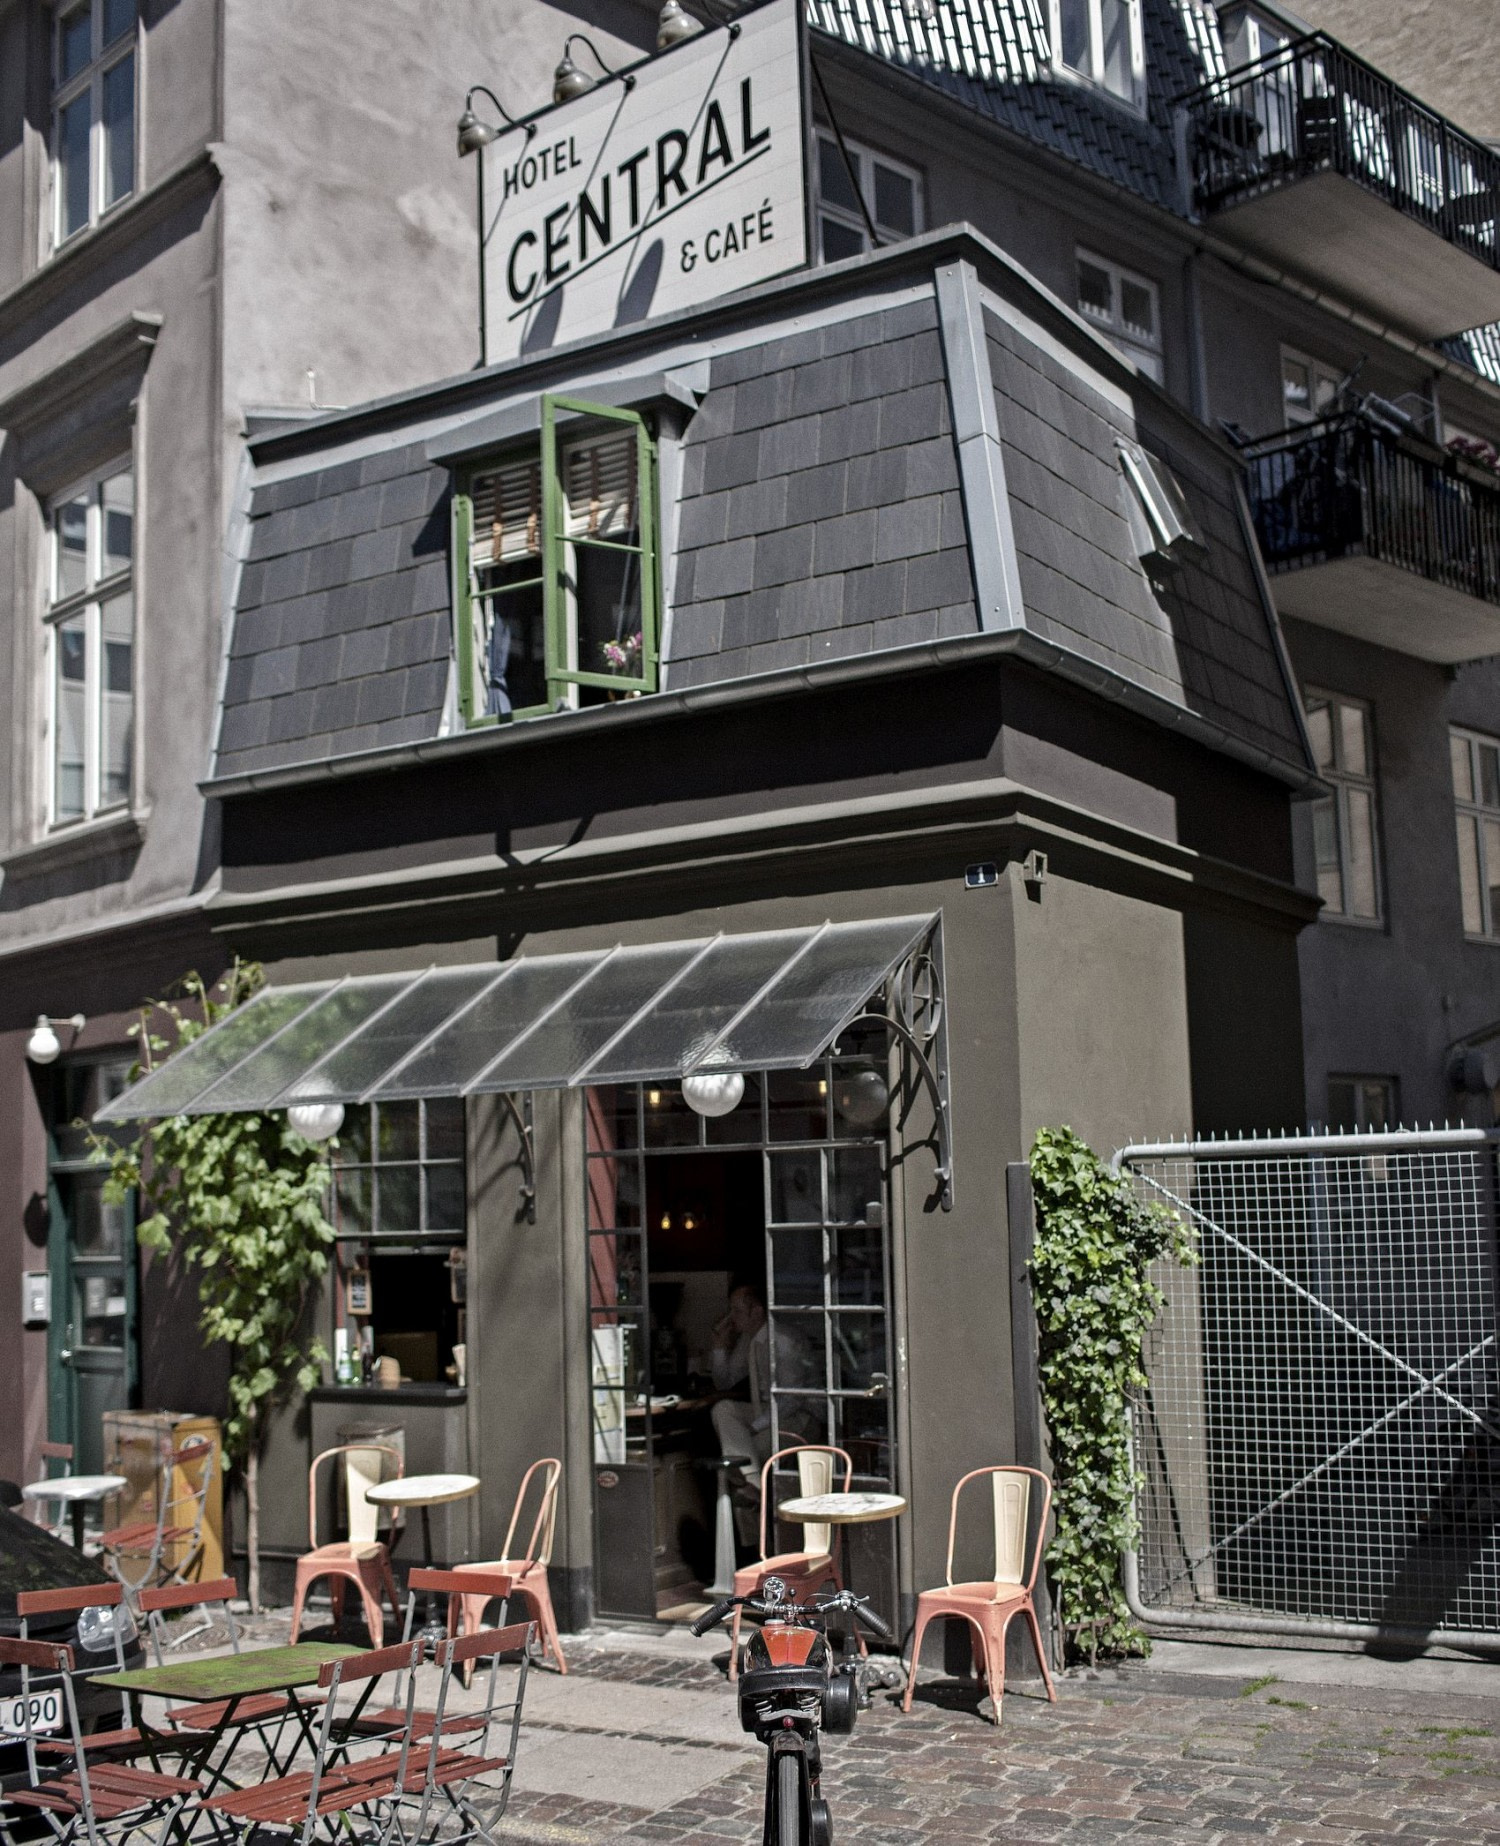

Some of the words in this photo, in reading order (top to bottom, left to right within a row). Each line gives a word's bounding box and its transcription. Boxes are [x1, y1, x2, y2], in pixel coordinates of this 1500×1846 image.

[503, 136, 582, 199] HOTEL
[507, 76, 770, 303] CENTRAL
[681, 240, 698, 273] &
[704, 198, 773, 263] CAFÉ
[977, 866, 986, 884] 1
[13, 1696, 57, 1727] 090
